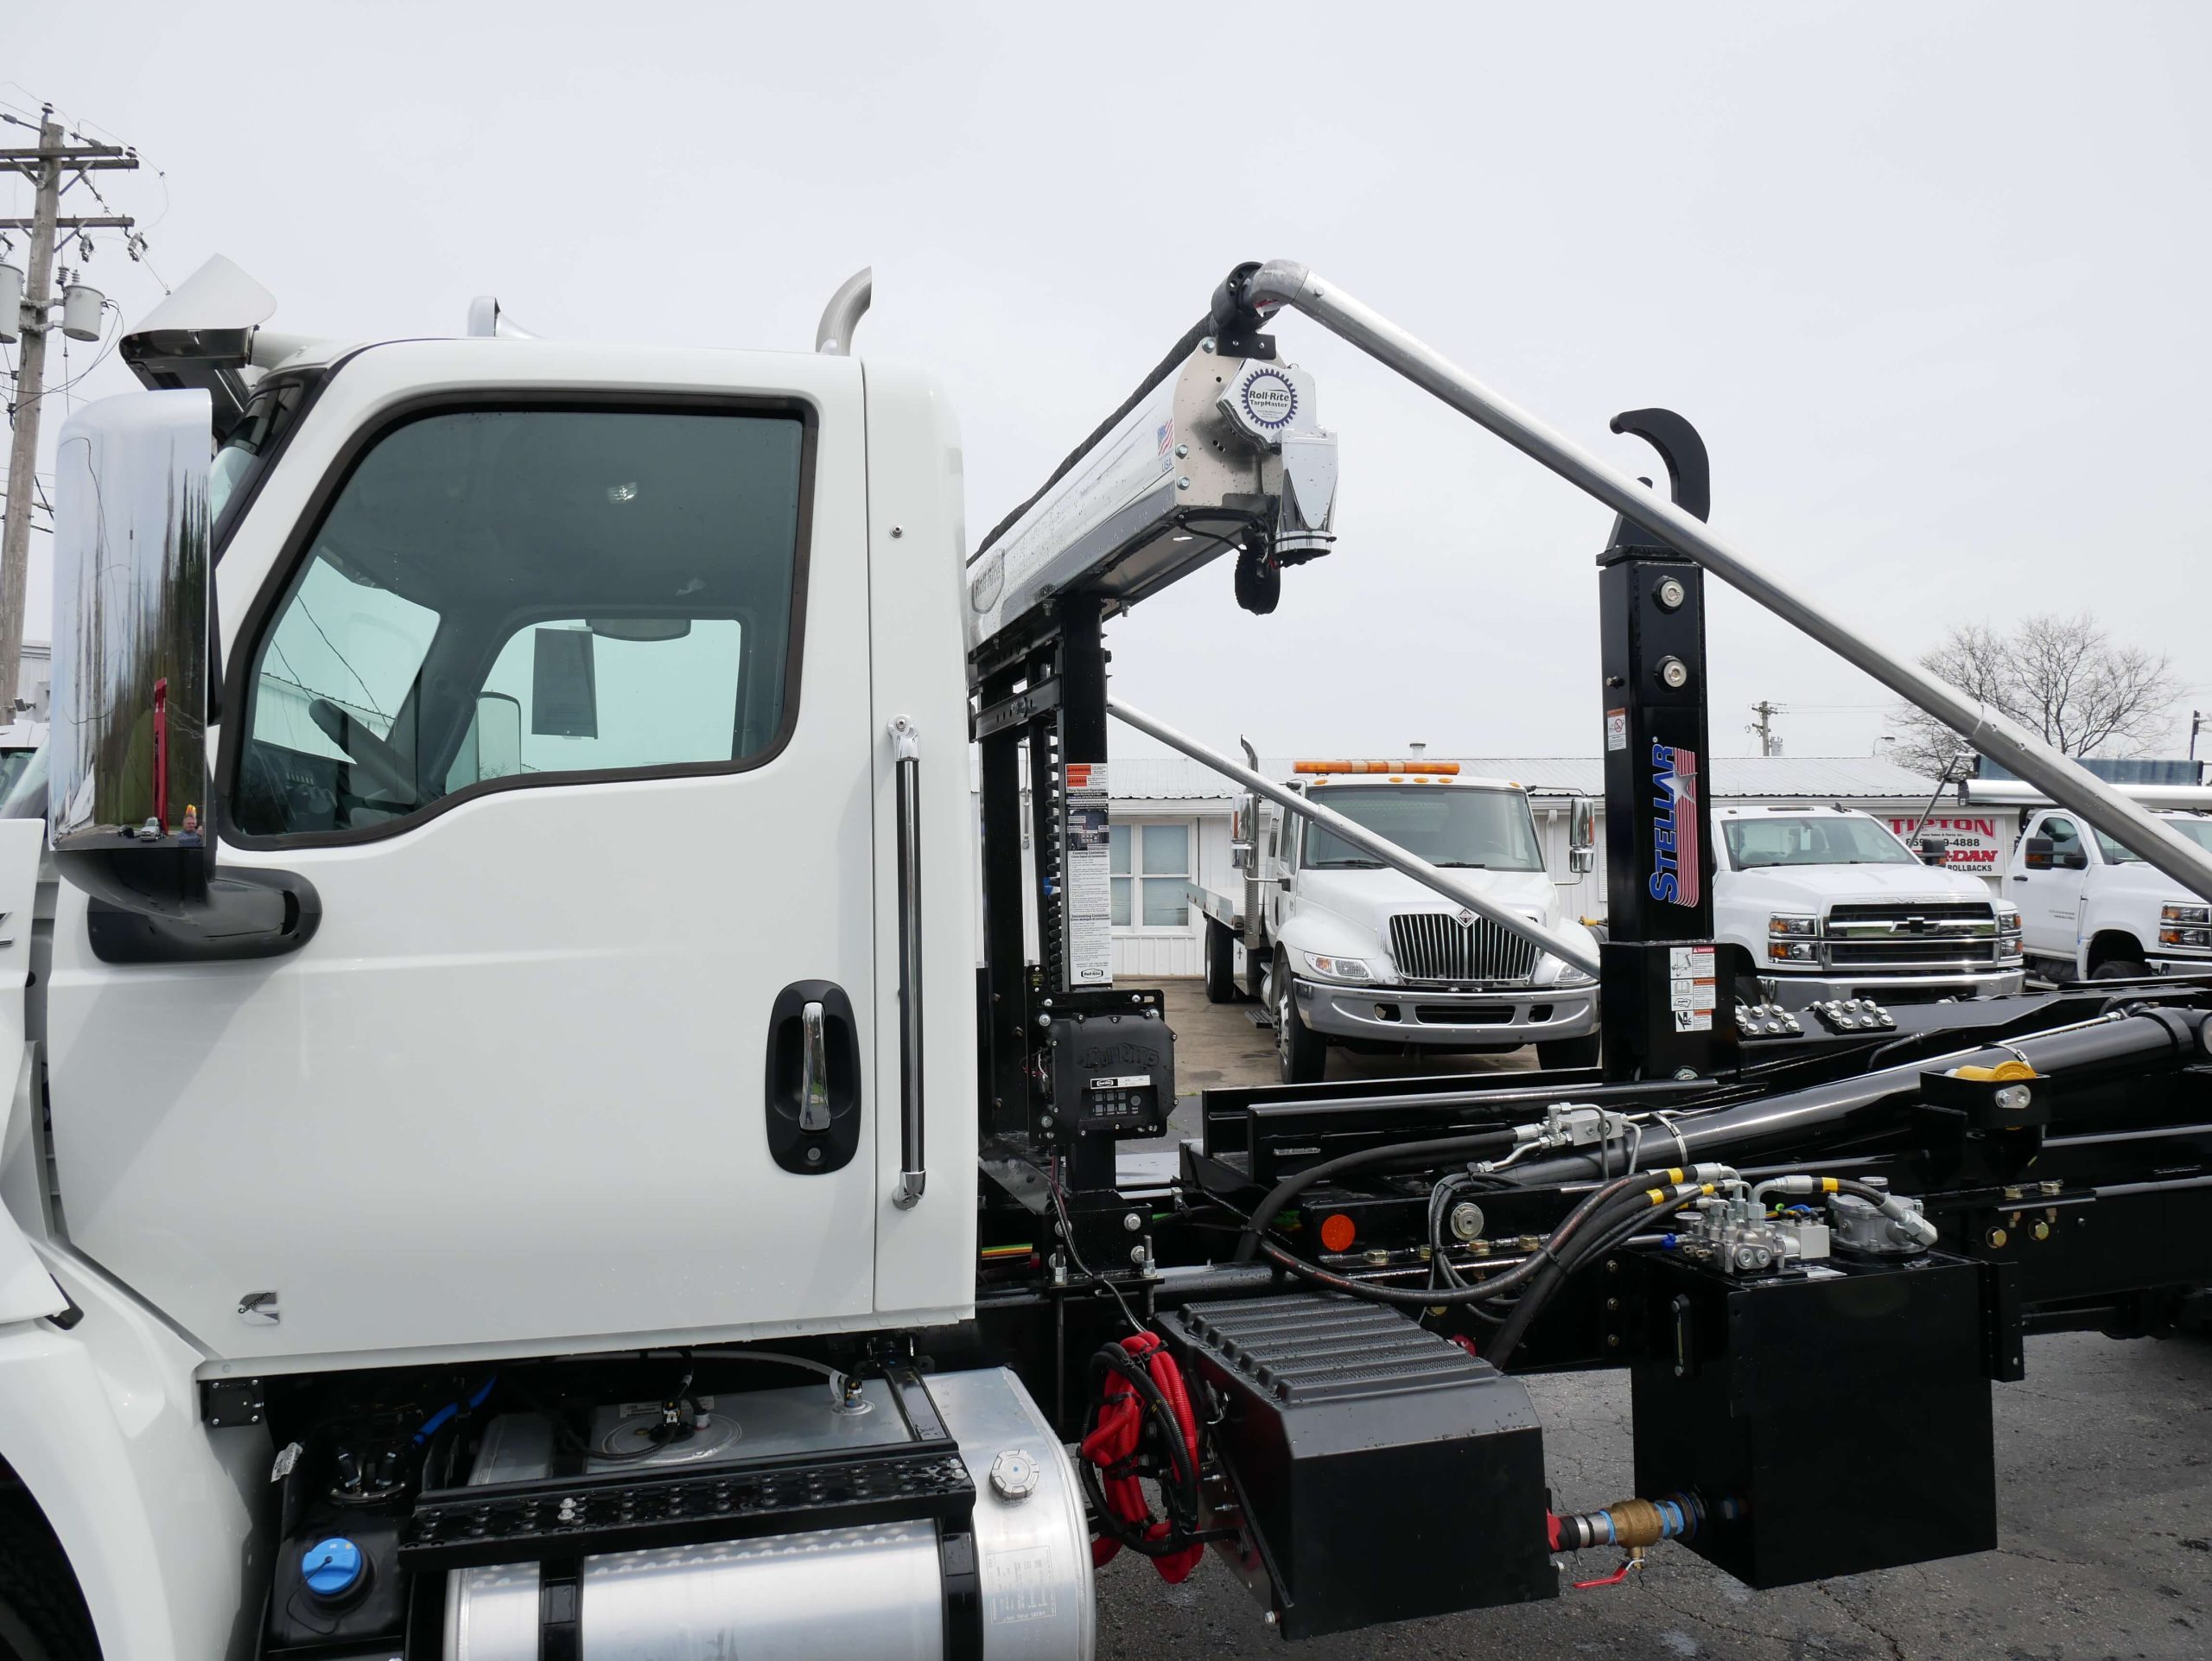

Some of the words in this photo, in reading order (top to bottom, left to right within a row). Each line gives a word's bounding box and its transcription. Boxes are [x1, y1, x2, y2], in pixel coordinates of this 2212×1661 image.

[1249, 399, 1288, 408] TarpMaster
[1161, 457, 1173, 473] USA
[1649, 743, 1679, 904] STELLAR
[1887, 818, 1996, 840] TIPTON
[238, 1292, 272, 1314] Cummins
